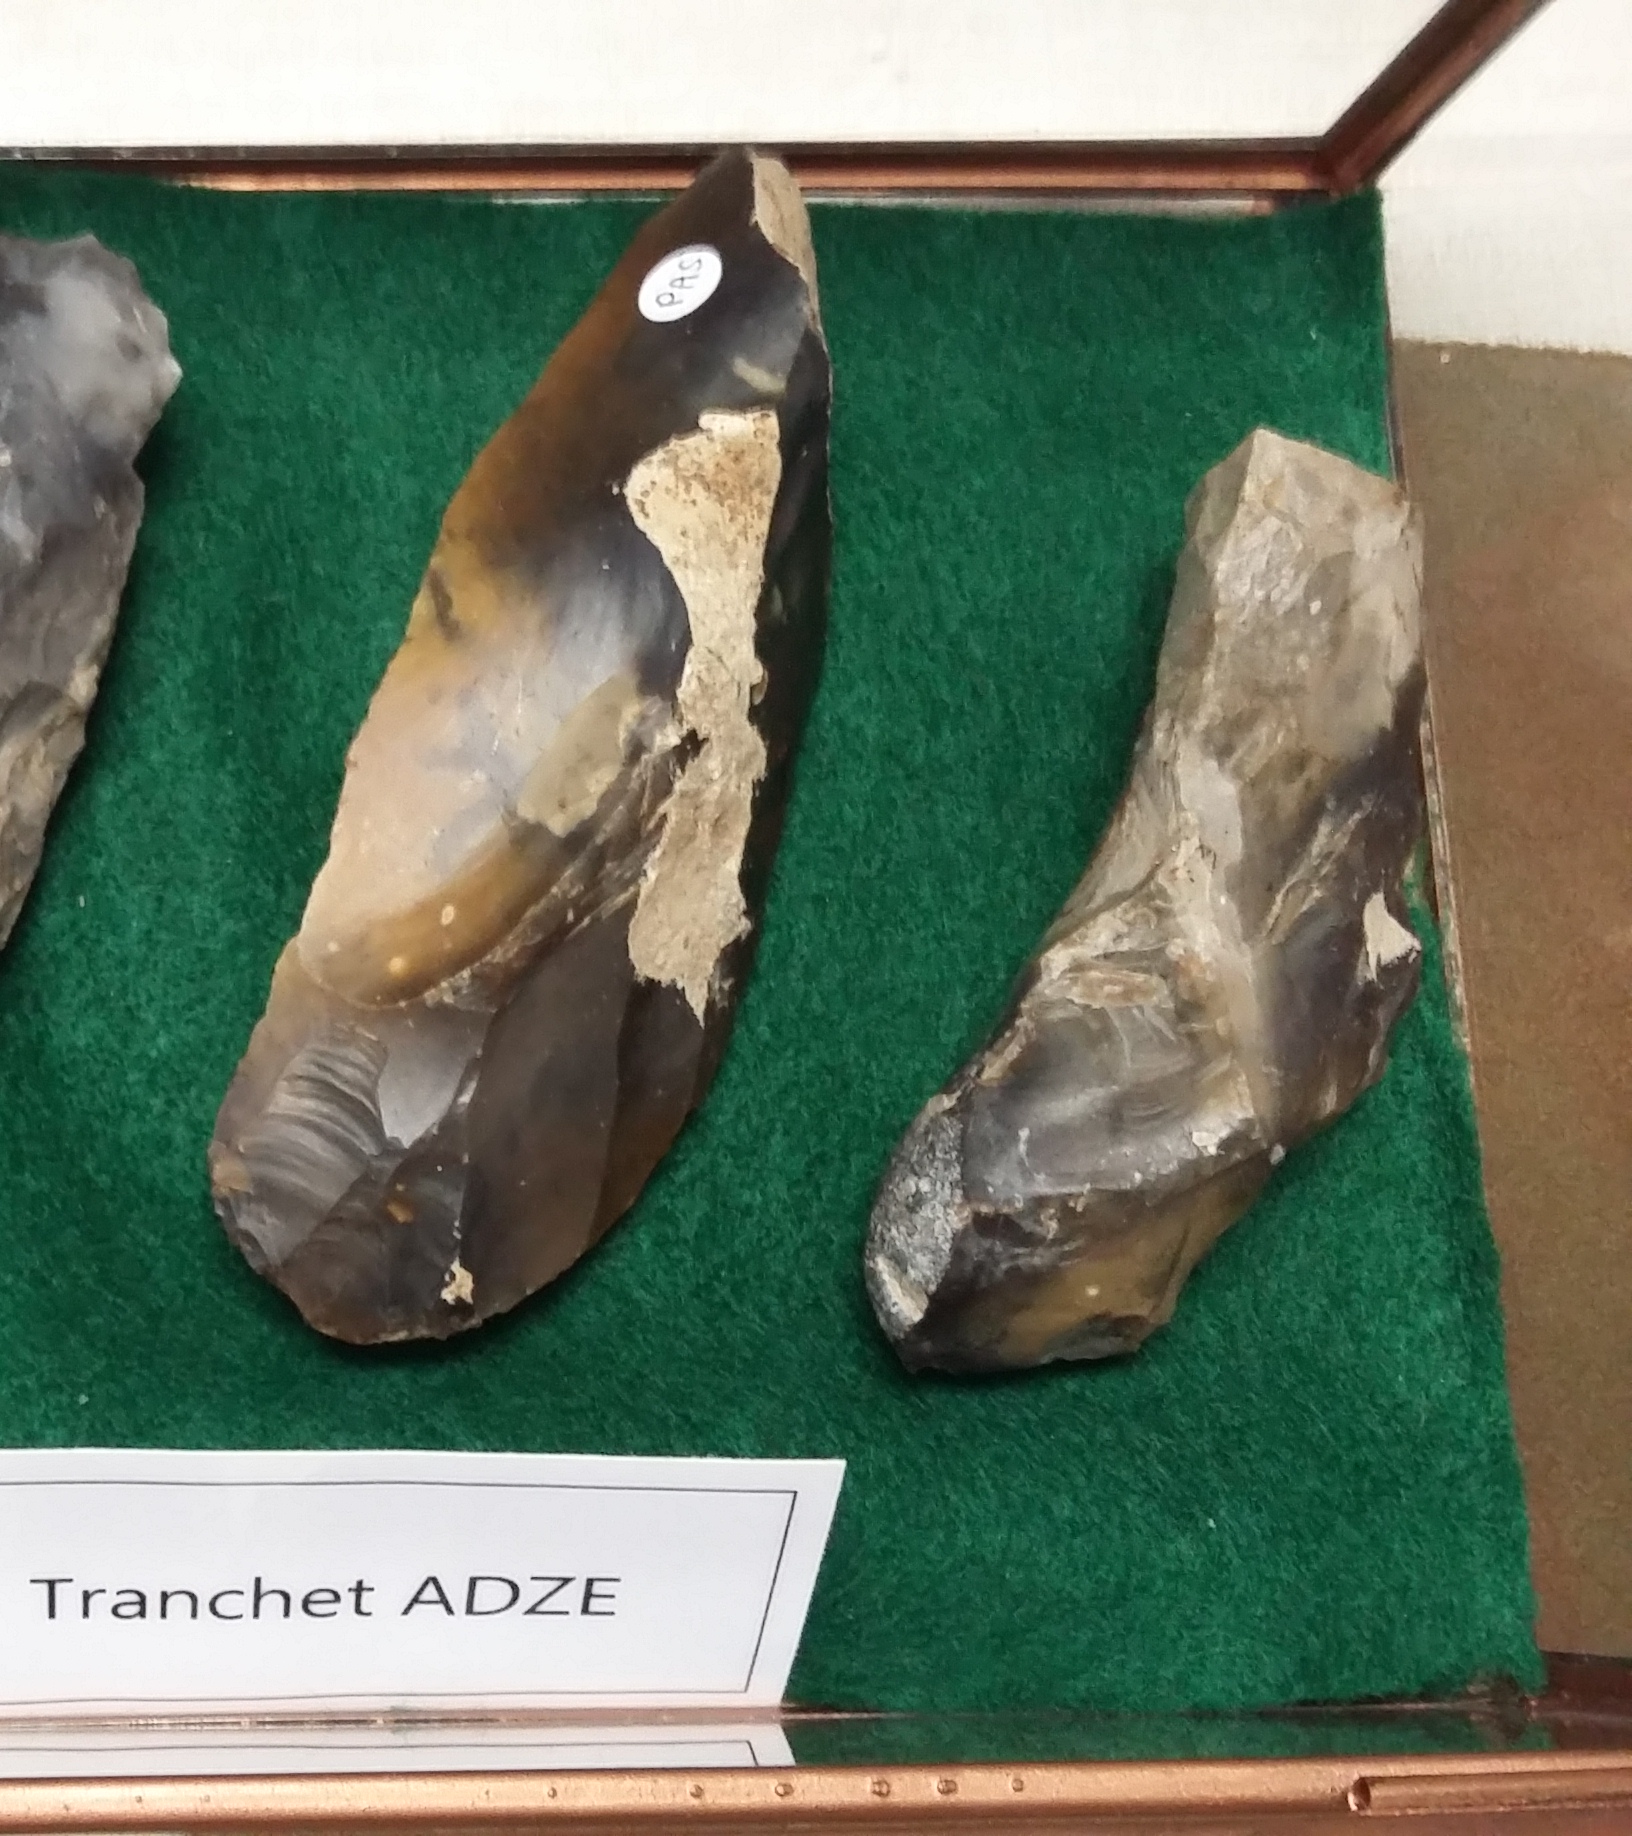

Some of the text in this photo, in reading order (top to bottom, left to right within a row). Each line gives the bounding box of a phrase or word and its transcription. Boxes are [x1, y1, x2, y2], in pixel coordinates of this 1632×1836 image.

[655, 258, 703, 308] PAS
[29, 1575, 621, 1620] Tranchet ADZE
